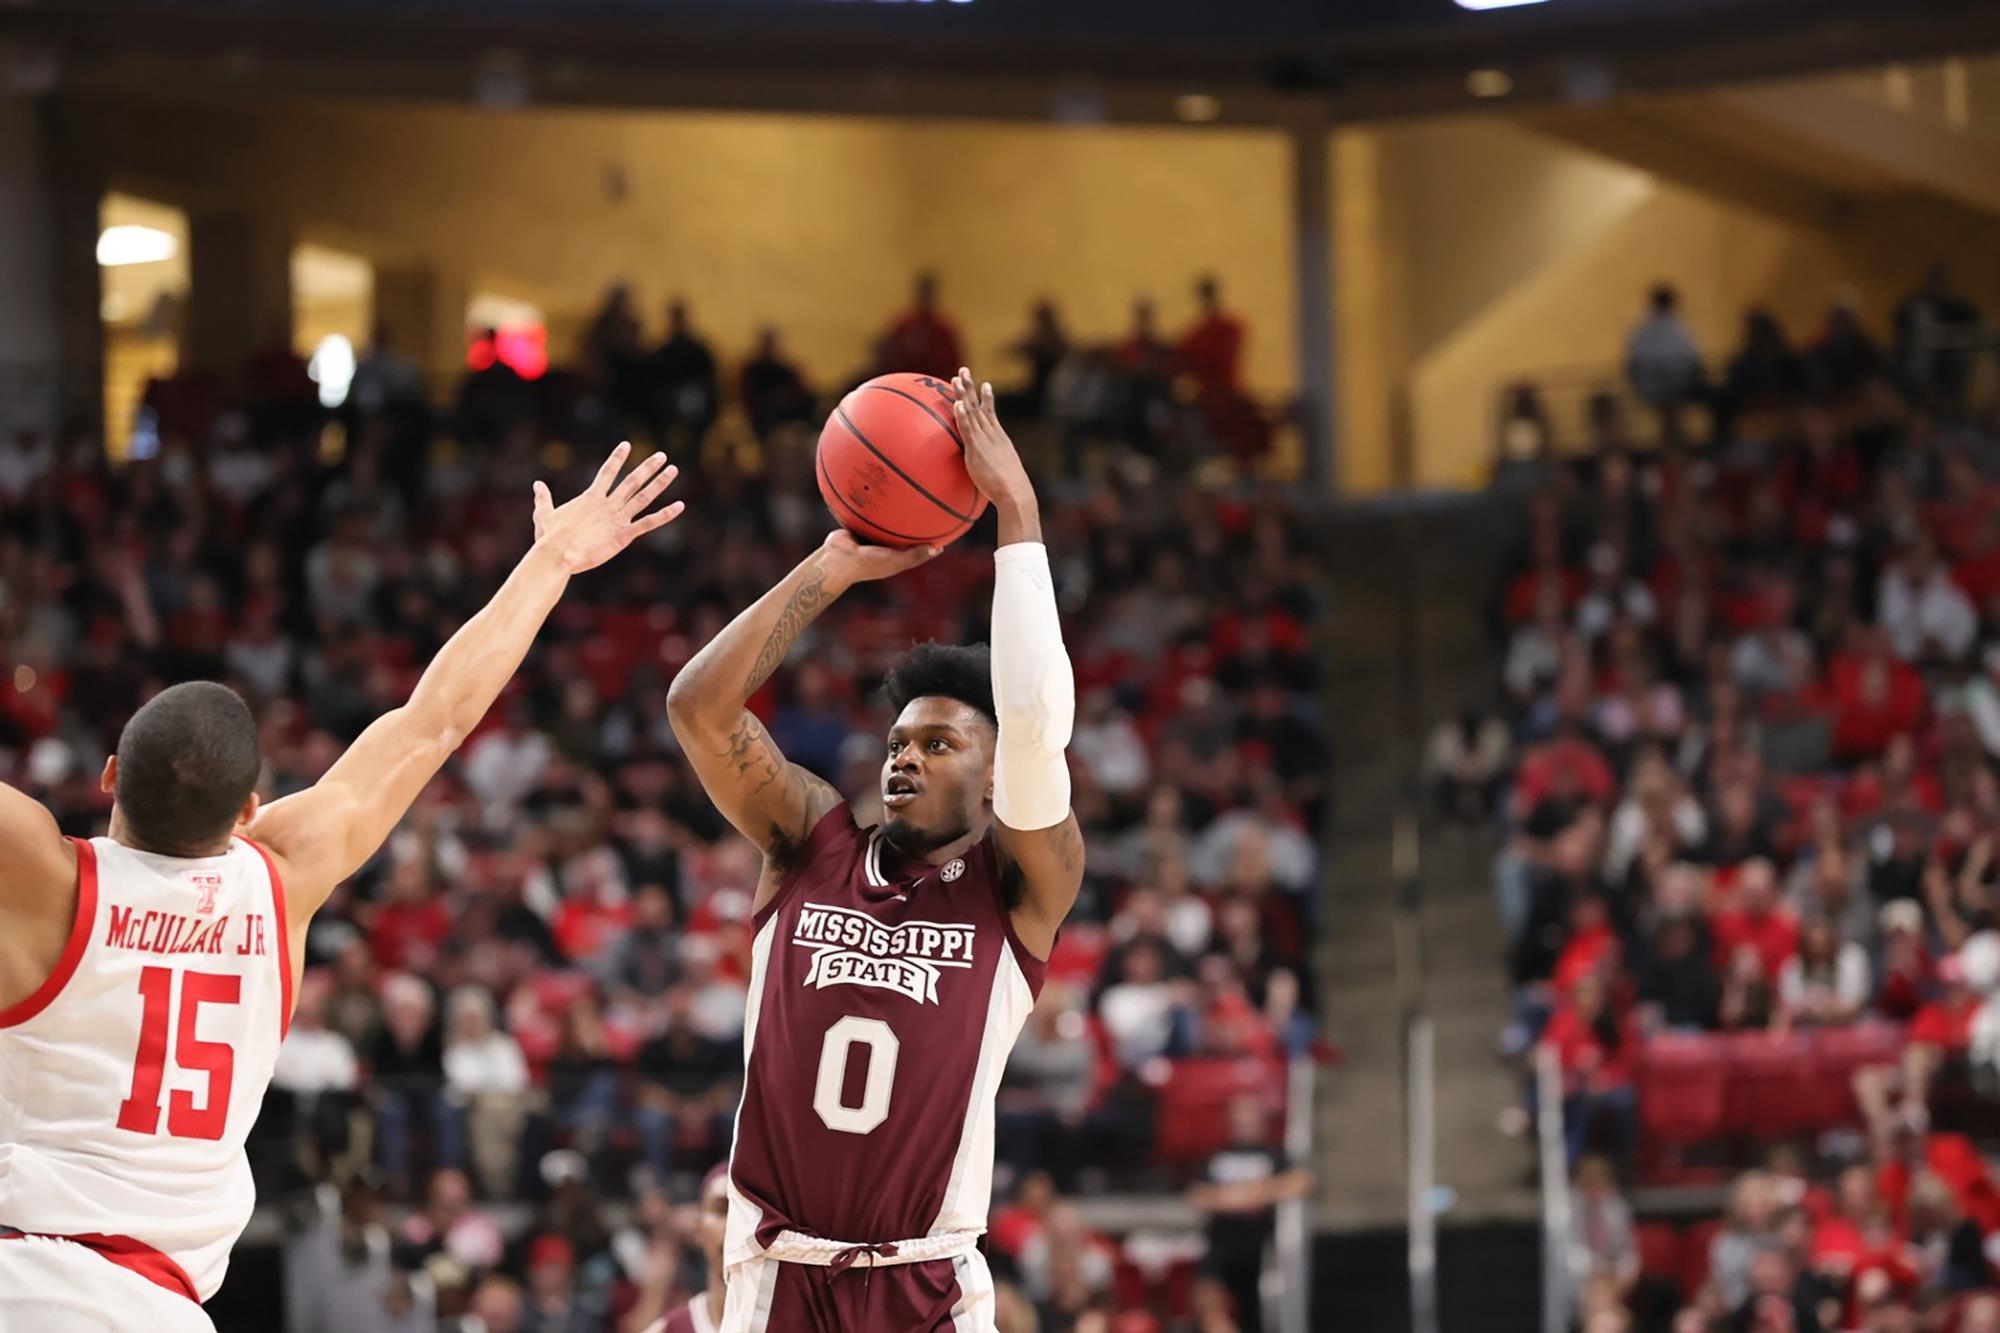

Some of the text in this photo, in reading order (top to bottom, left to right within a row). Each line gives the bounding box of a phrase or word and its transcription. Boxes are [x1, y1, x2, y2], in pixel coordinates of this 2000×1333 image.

[941, 860, 965, 881] SEC
[105, 905, 266, 955] McCULLAR JR
[795, 909, 976, 960] MISSISSIPPI
[826, 957, 915, 991] STATE
[117, 966, 242, 1141] 15
[812, 1015, 900, 1135] 0
